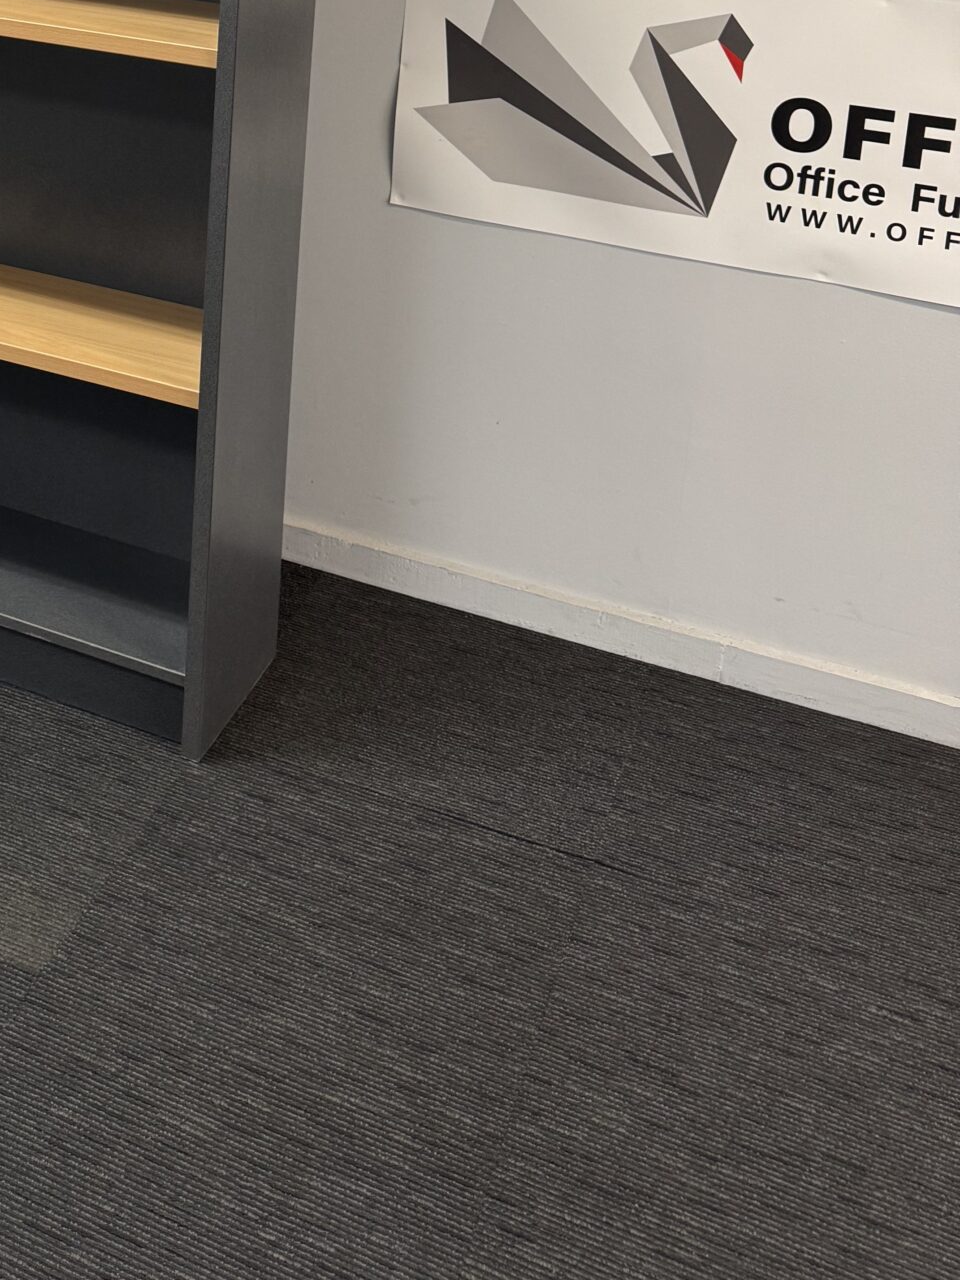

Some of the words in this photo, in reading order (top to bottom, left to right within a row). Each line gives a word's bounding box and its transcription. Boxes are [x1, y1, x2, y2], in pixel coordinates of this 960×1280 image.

[771, 97, 957, 169] OFF
[763, 162, 886, 206] Office
[911, 183, 960, 219] Fu
[766, 202, 960, 250] WWW.OFF
